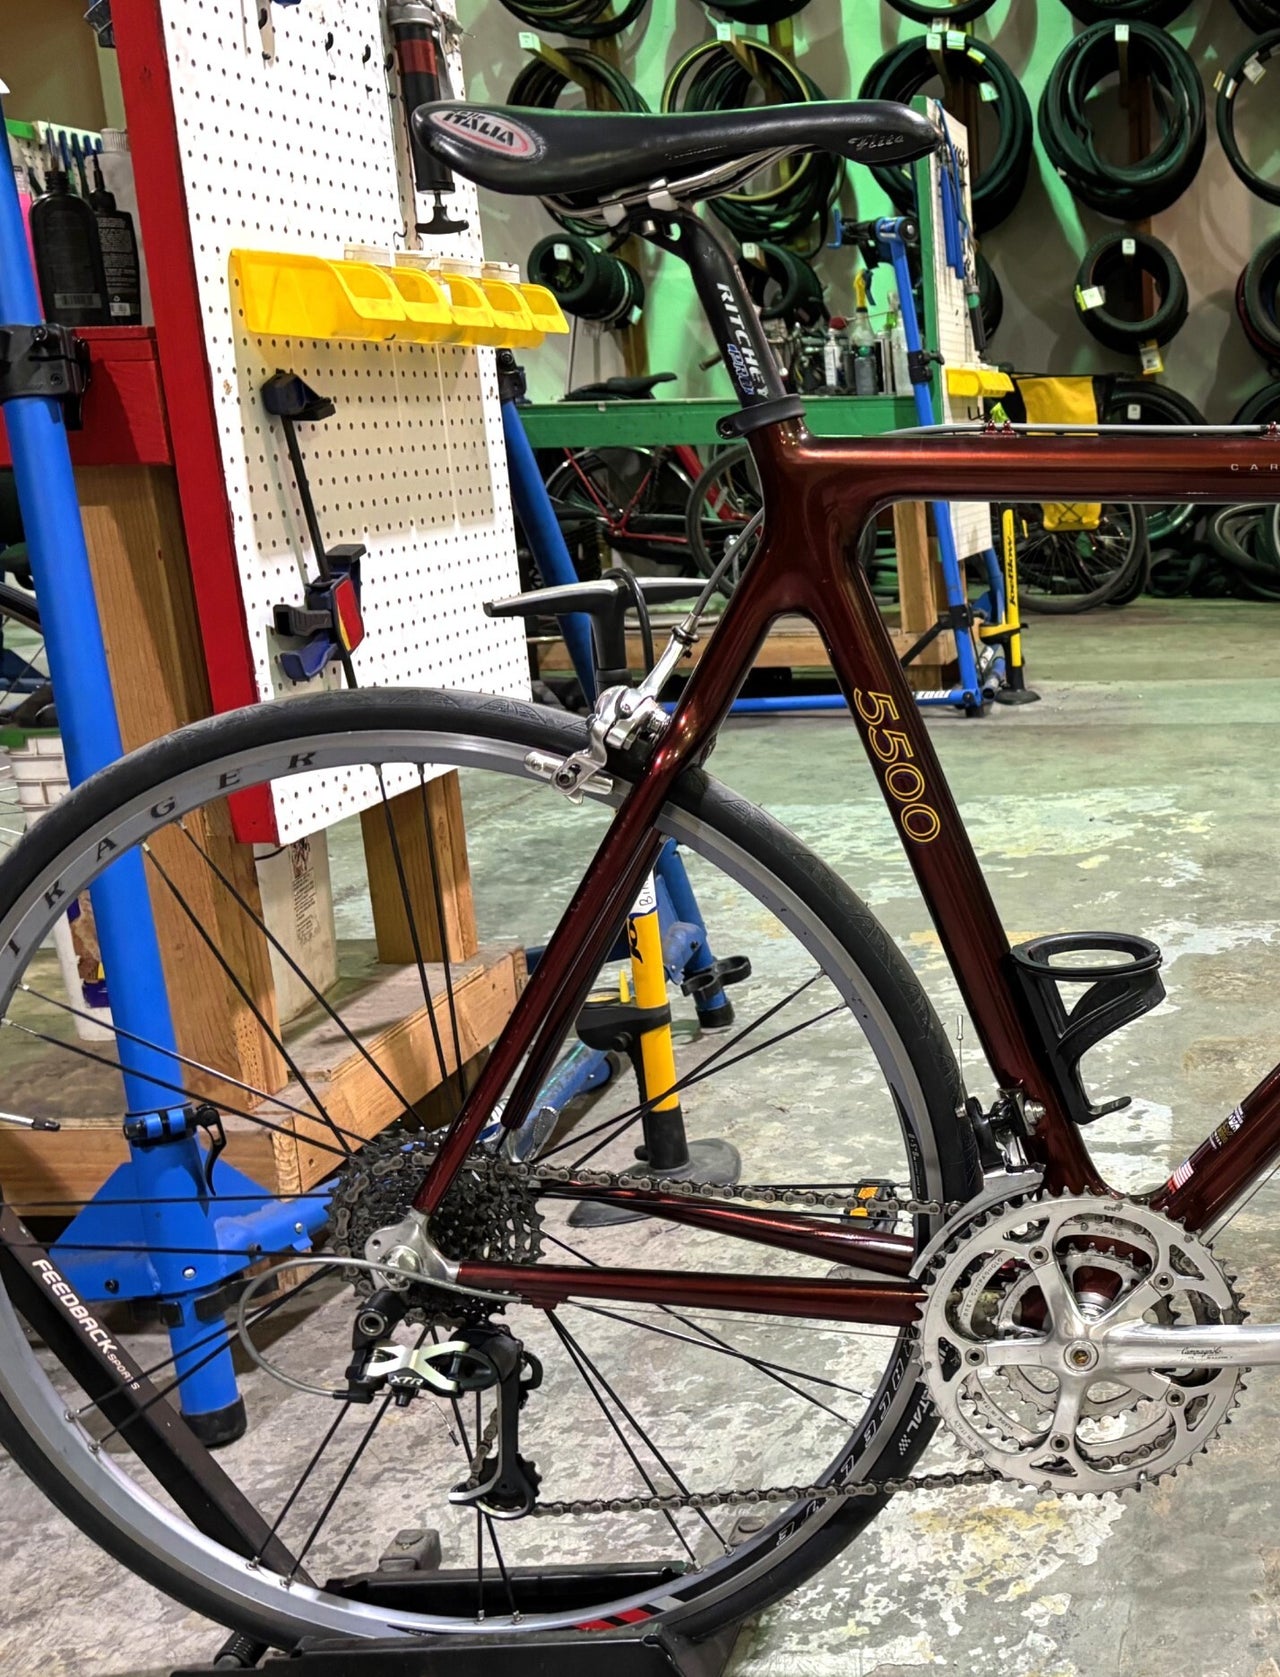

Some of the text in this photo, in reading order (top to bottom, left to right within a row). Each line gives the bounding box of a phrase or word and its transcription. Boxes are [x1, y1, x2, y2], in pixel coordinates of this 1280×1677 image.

[443, 113, 514, 146] ITALIA
[716, 283, 769, 400] RITCHEY
[853, 687, 941, 843] 5500
[32, 1259, 118, 1354] FEEDBACK
[391, 1375, 424, 1386] XTR
